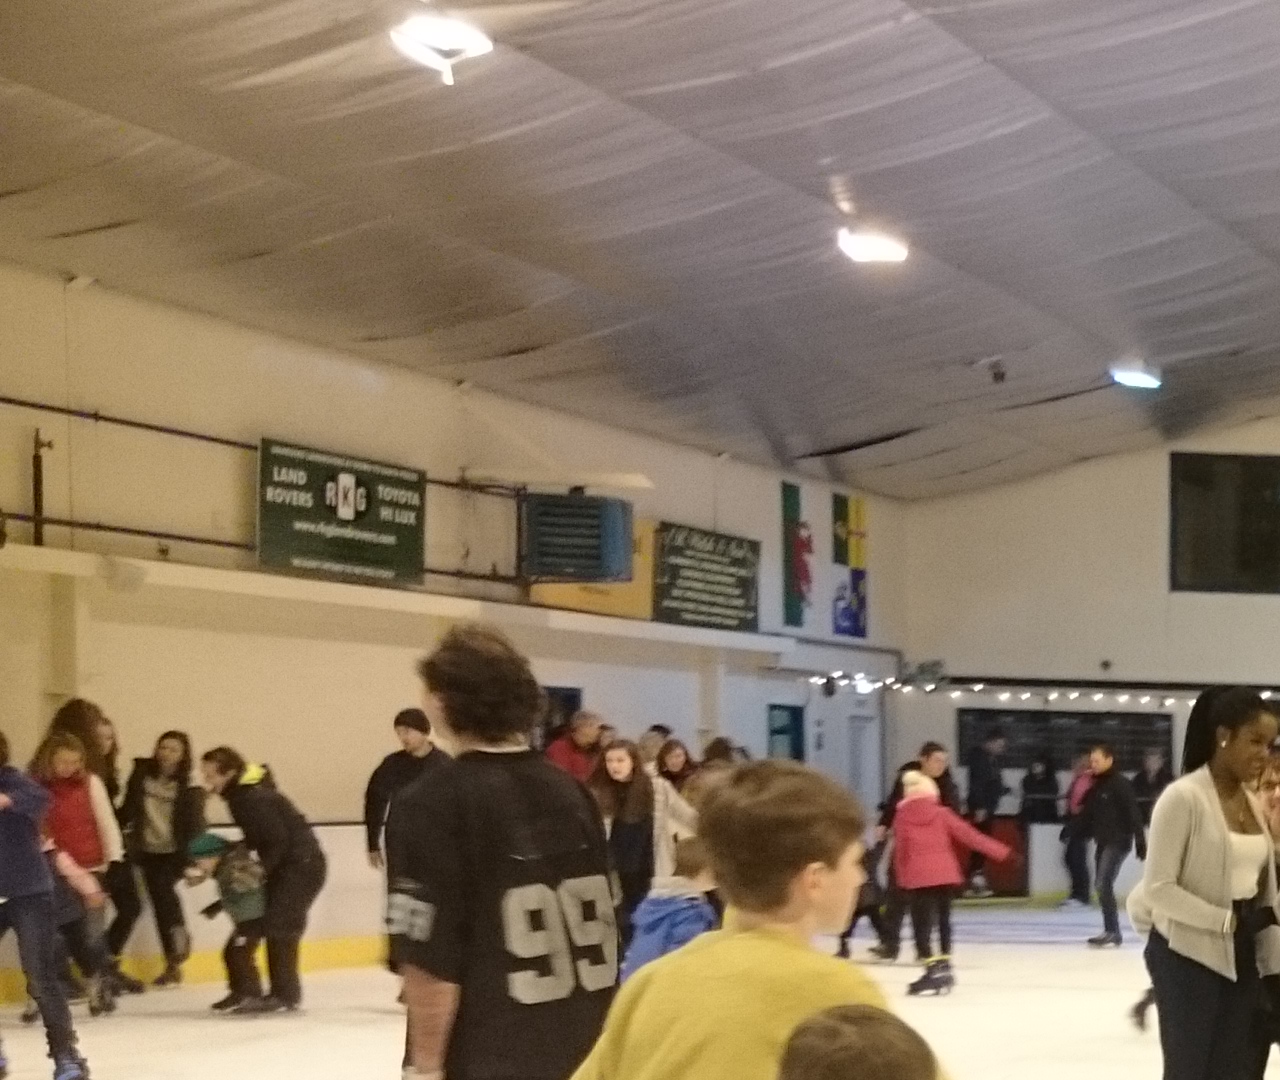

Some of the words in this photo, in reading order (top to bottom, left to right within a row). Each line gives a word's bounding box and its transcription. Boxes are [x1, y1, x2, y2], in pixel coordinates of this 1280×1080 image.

[272, 466, 308, 486] LAND
[266, 485, 314, 508] ROVERS
[377, 484, 420, 507] TOYOTA
[394, 508, 417, 526] LUX
[502, 874, 618, 1005] 99
